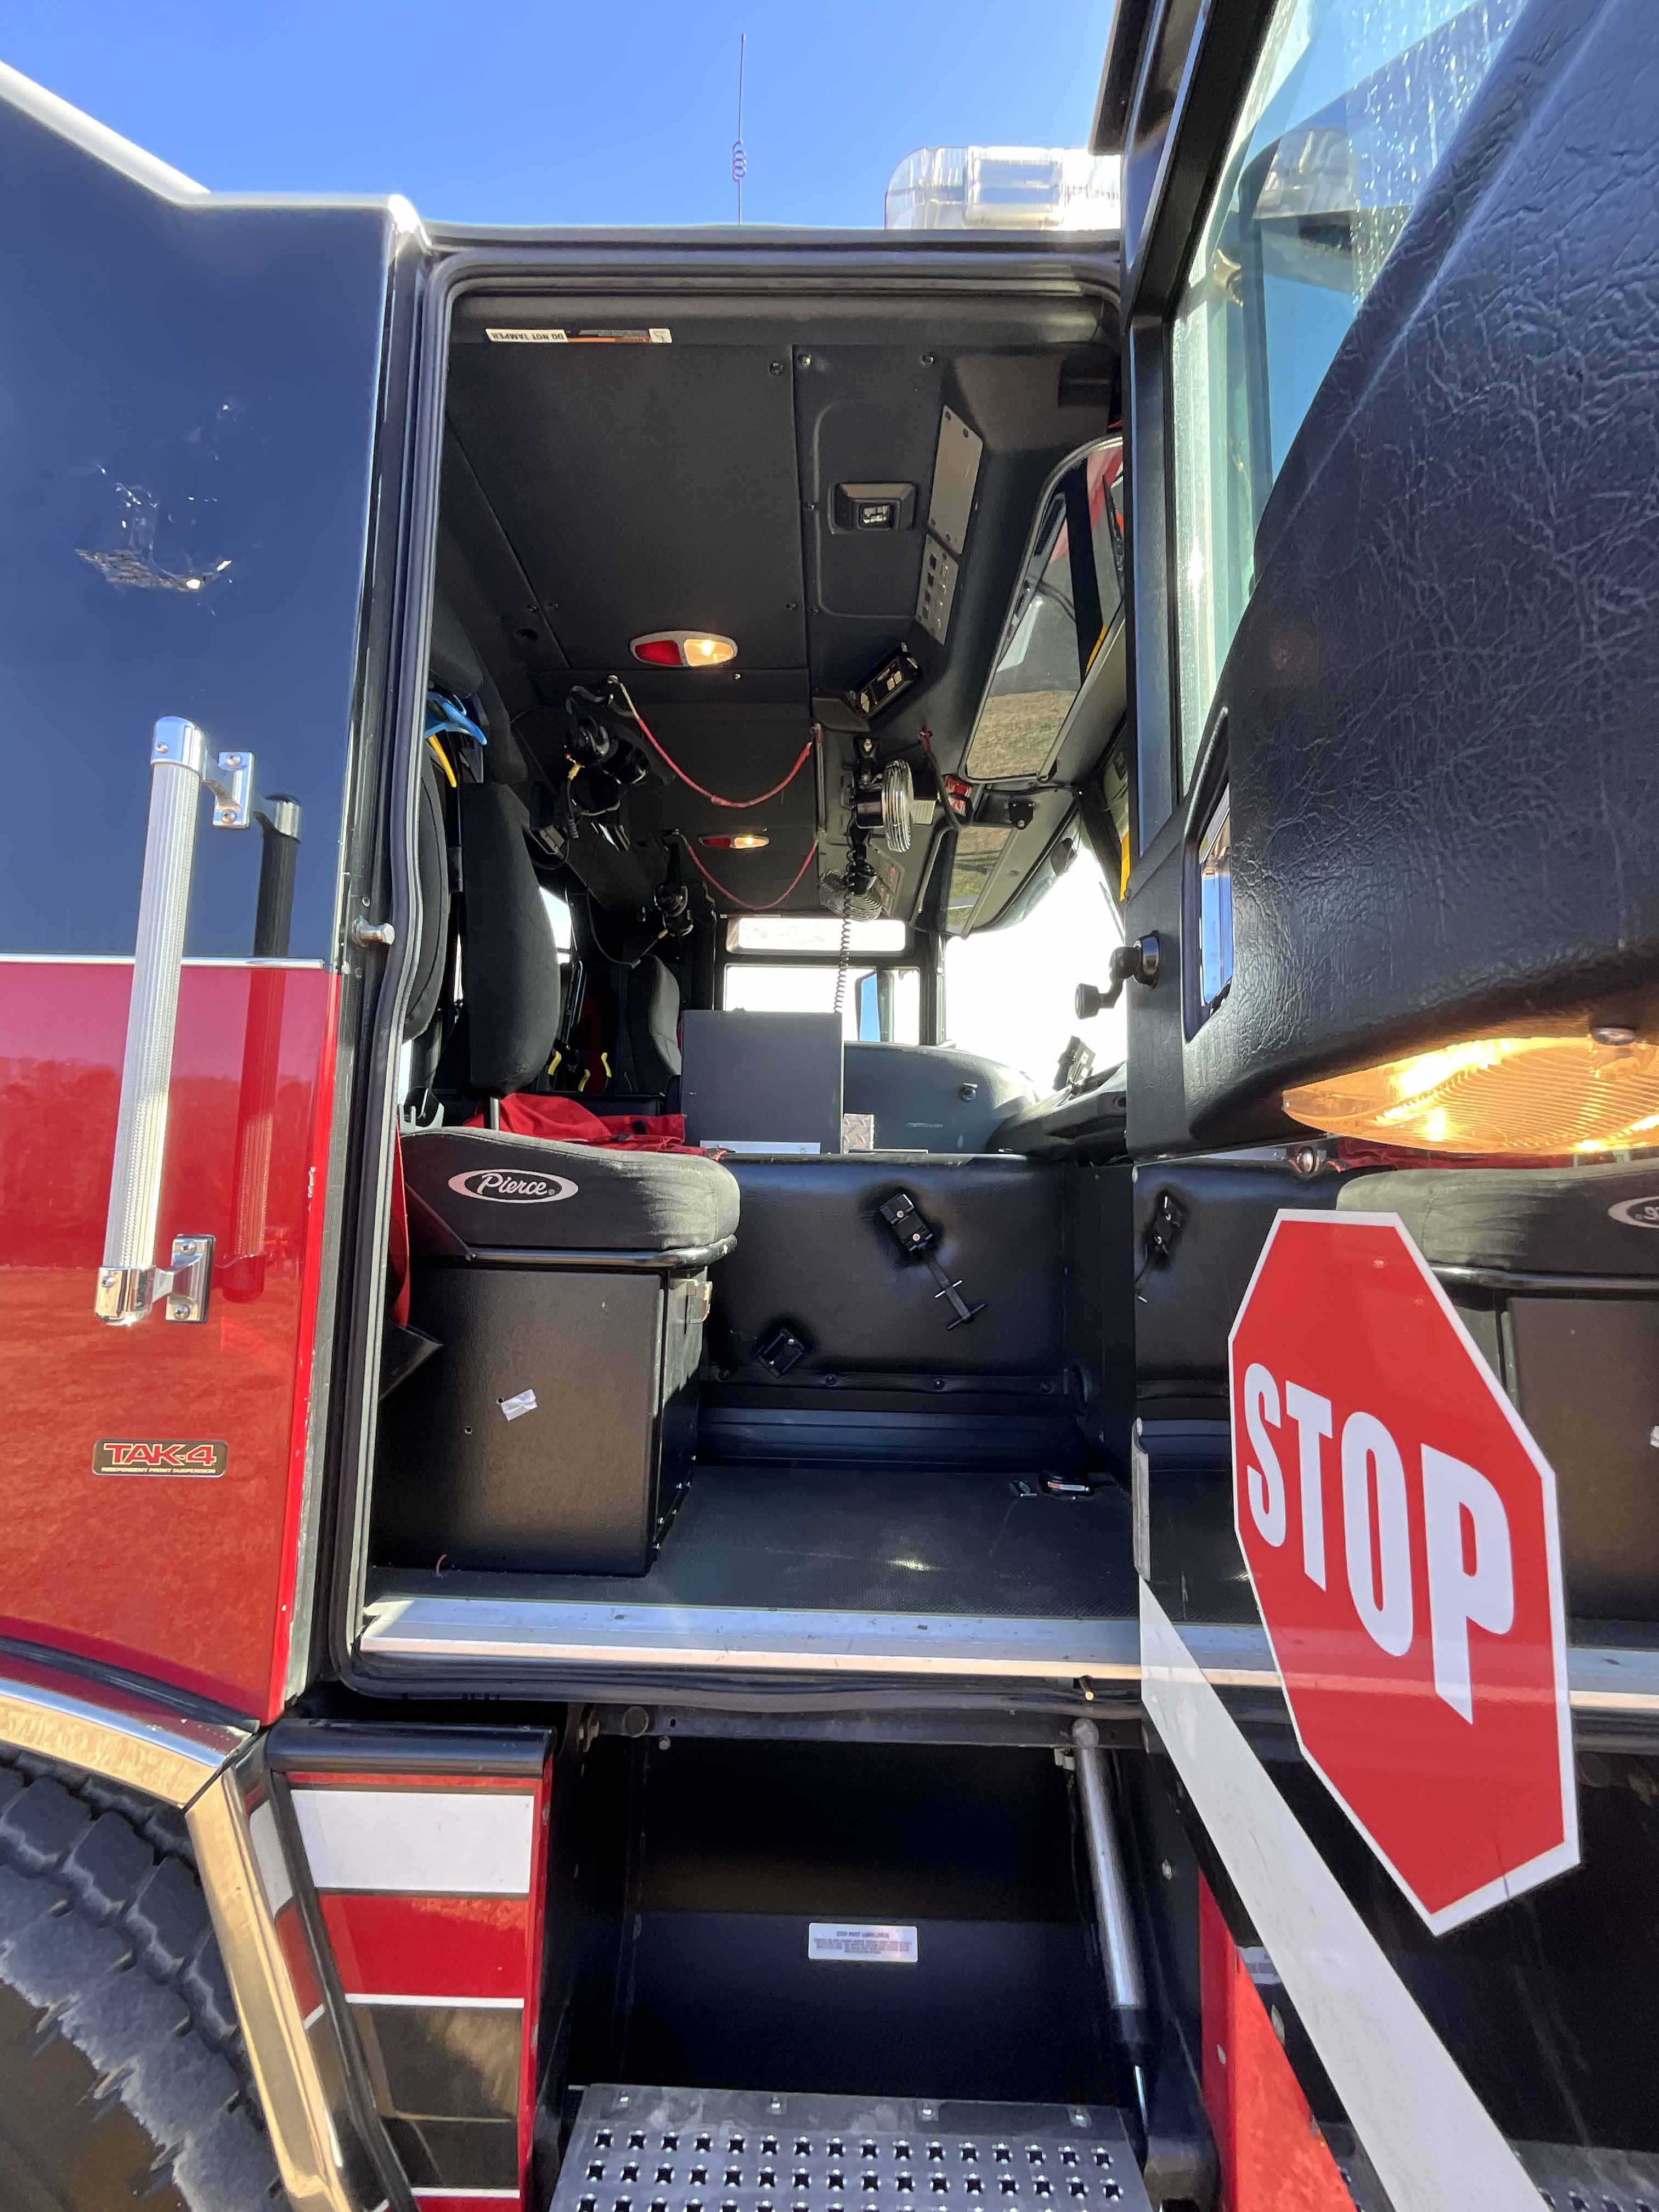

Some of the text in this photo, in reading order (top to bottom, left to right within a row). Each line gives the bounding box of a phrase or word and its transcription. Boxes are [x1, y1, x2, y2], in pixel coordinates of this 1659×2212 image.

[477, 1172, 548, 1195] Pierce
[103, 1443, 217, 1466] TAK-4
[1244, 1363, 1514, 1725] STOP
